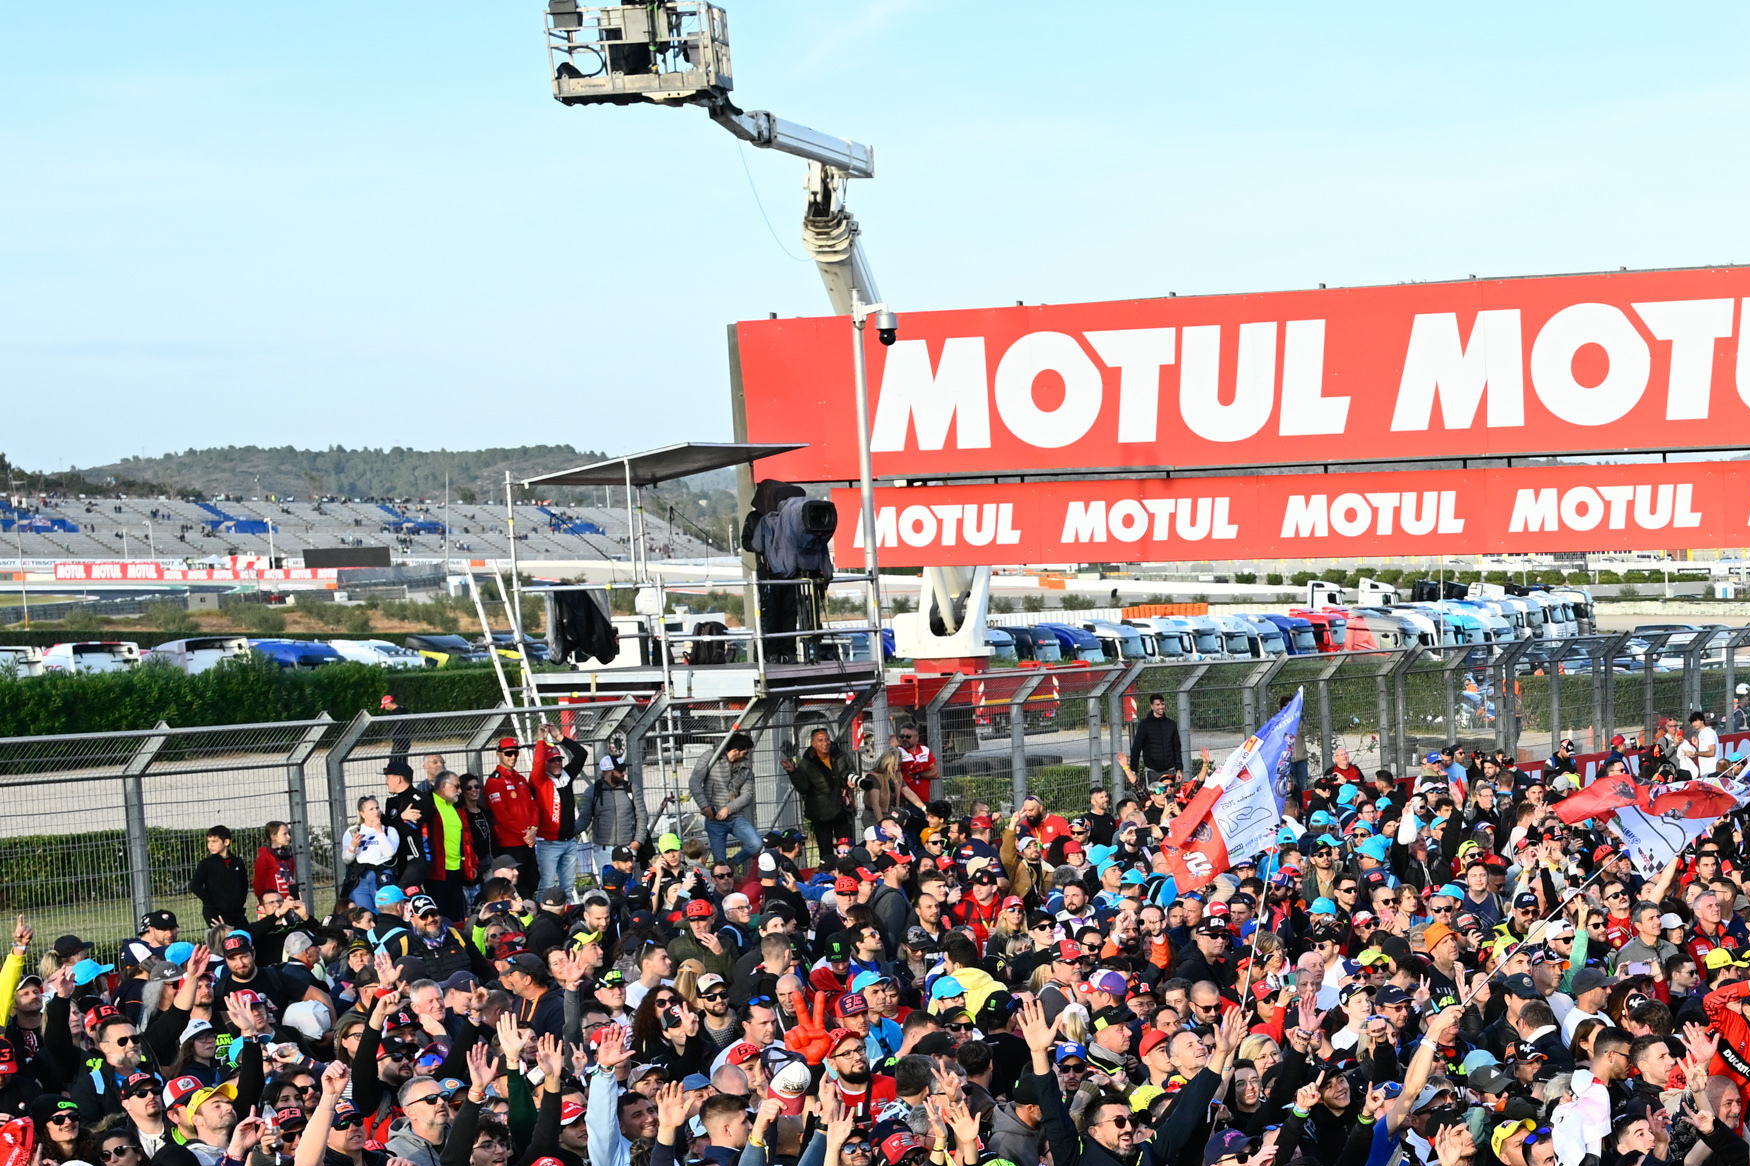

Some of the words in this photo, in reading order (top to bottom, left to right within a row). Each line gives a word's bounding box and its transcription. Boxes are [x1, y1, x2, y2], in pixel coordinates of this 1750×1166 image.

[870, 319, 1351, 452] MOTUL
[853, 503, 1021, 547] MOTUL
[1061, 497, 1238, 543] MOTUL
[1281, 491, 1464, 537] MOTUL
[1509, 484, 1702, 532] MOTUL
[56, 564, 85, 579] MOTUL
[91, 564, 122, 579] MOTUL
[127, 563, 157, 578] MOTUL
[604, 971, 621, 981] 46
[1437, 994, 1455, 1007] 46
[128, 1072, 150, 1086] 93
[278, 1109, 303, 1124] 93
